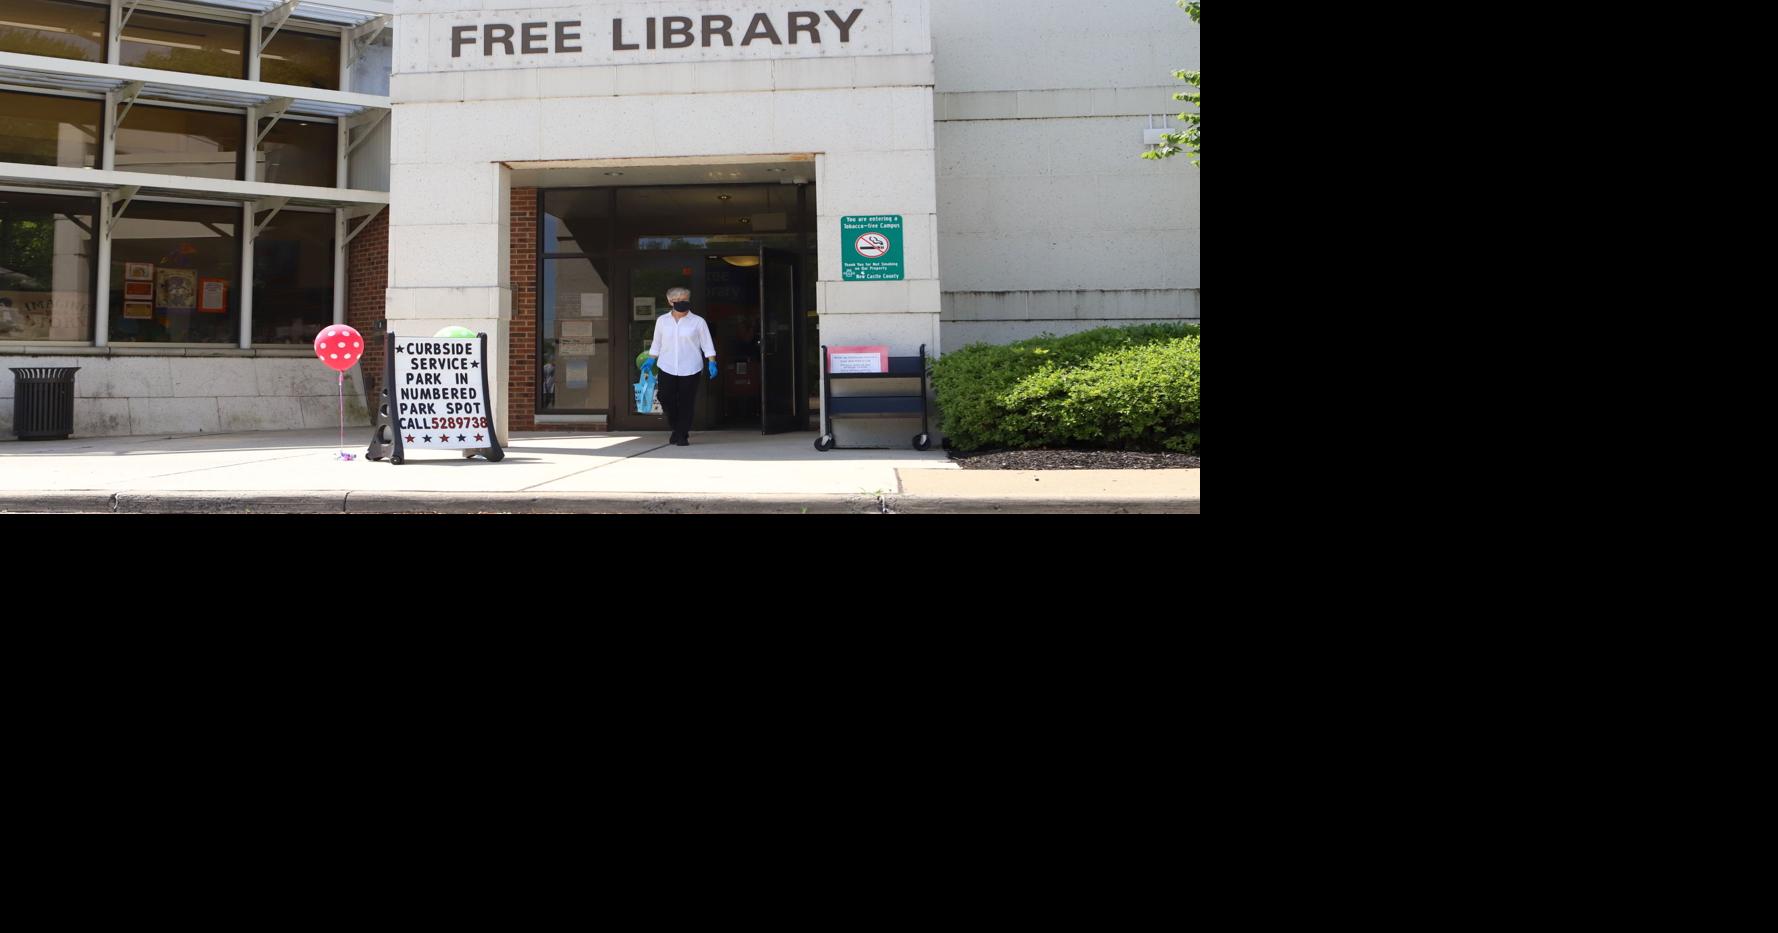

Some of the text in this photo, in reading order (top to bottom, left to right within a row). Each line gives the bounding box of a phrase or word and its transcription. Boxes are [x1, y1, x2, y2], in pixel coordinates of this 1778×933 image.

[451, 8, 863, 58] FREE LIBRARY
[406, 342, 473, 355] CURBSIDE
[410, 357, 469, 370] SERVICE
[406, 372, 469, 385] PARK IN
[400, 387, 477, 400] NUMBERED
[399, 402, 481, 415] PARK SPOT
